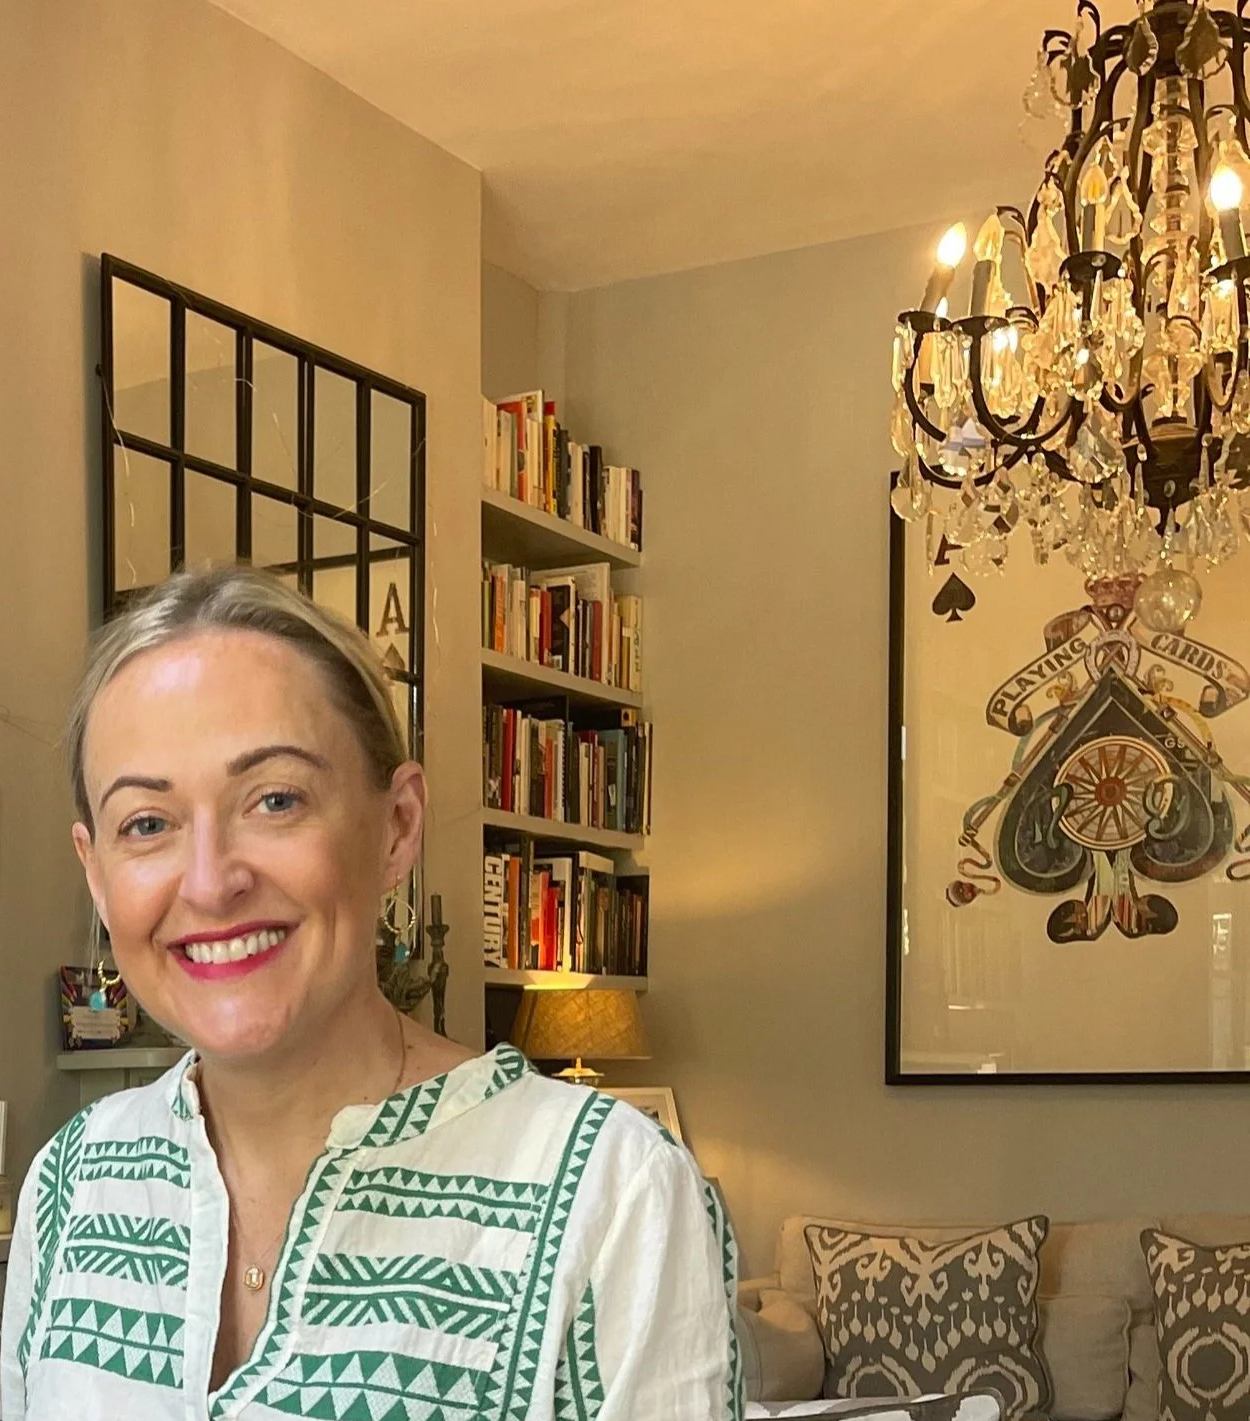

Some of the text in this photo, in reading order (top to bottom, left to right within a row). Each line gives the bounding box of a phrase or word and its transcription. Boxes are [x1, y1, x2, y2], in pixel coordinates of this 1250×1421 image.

[991, 634, 1227, 717] PLAYING CARDS
[483, 856, 502, 968] CENTURY
